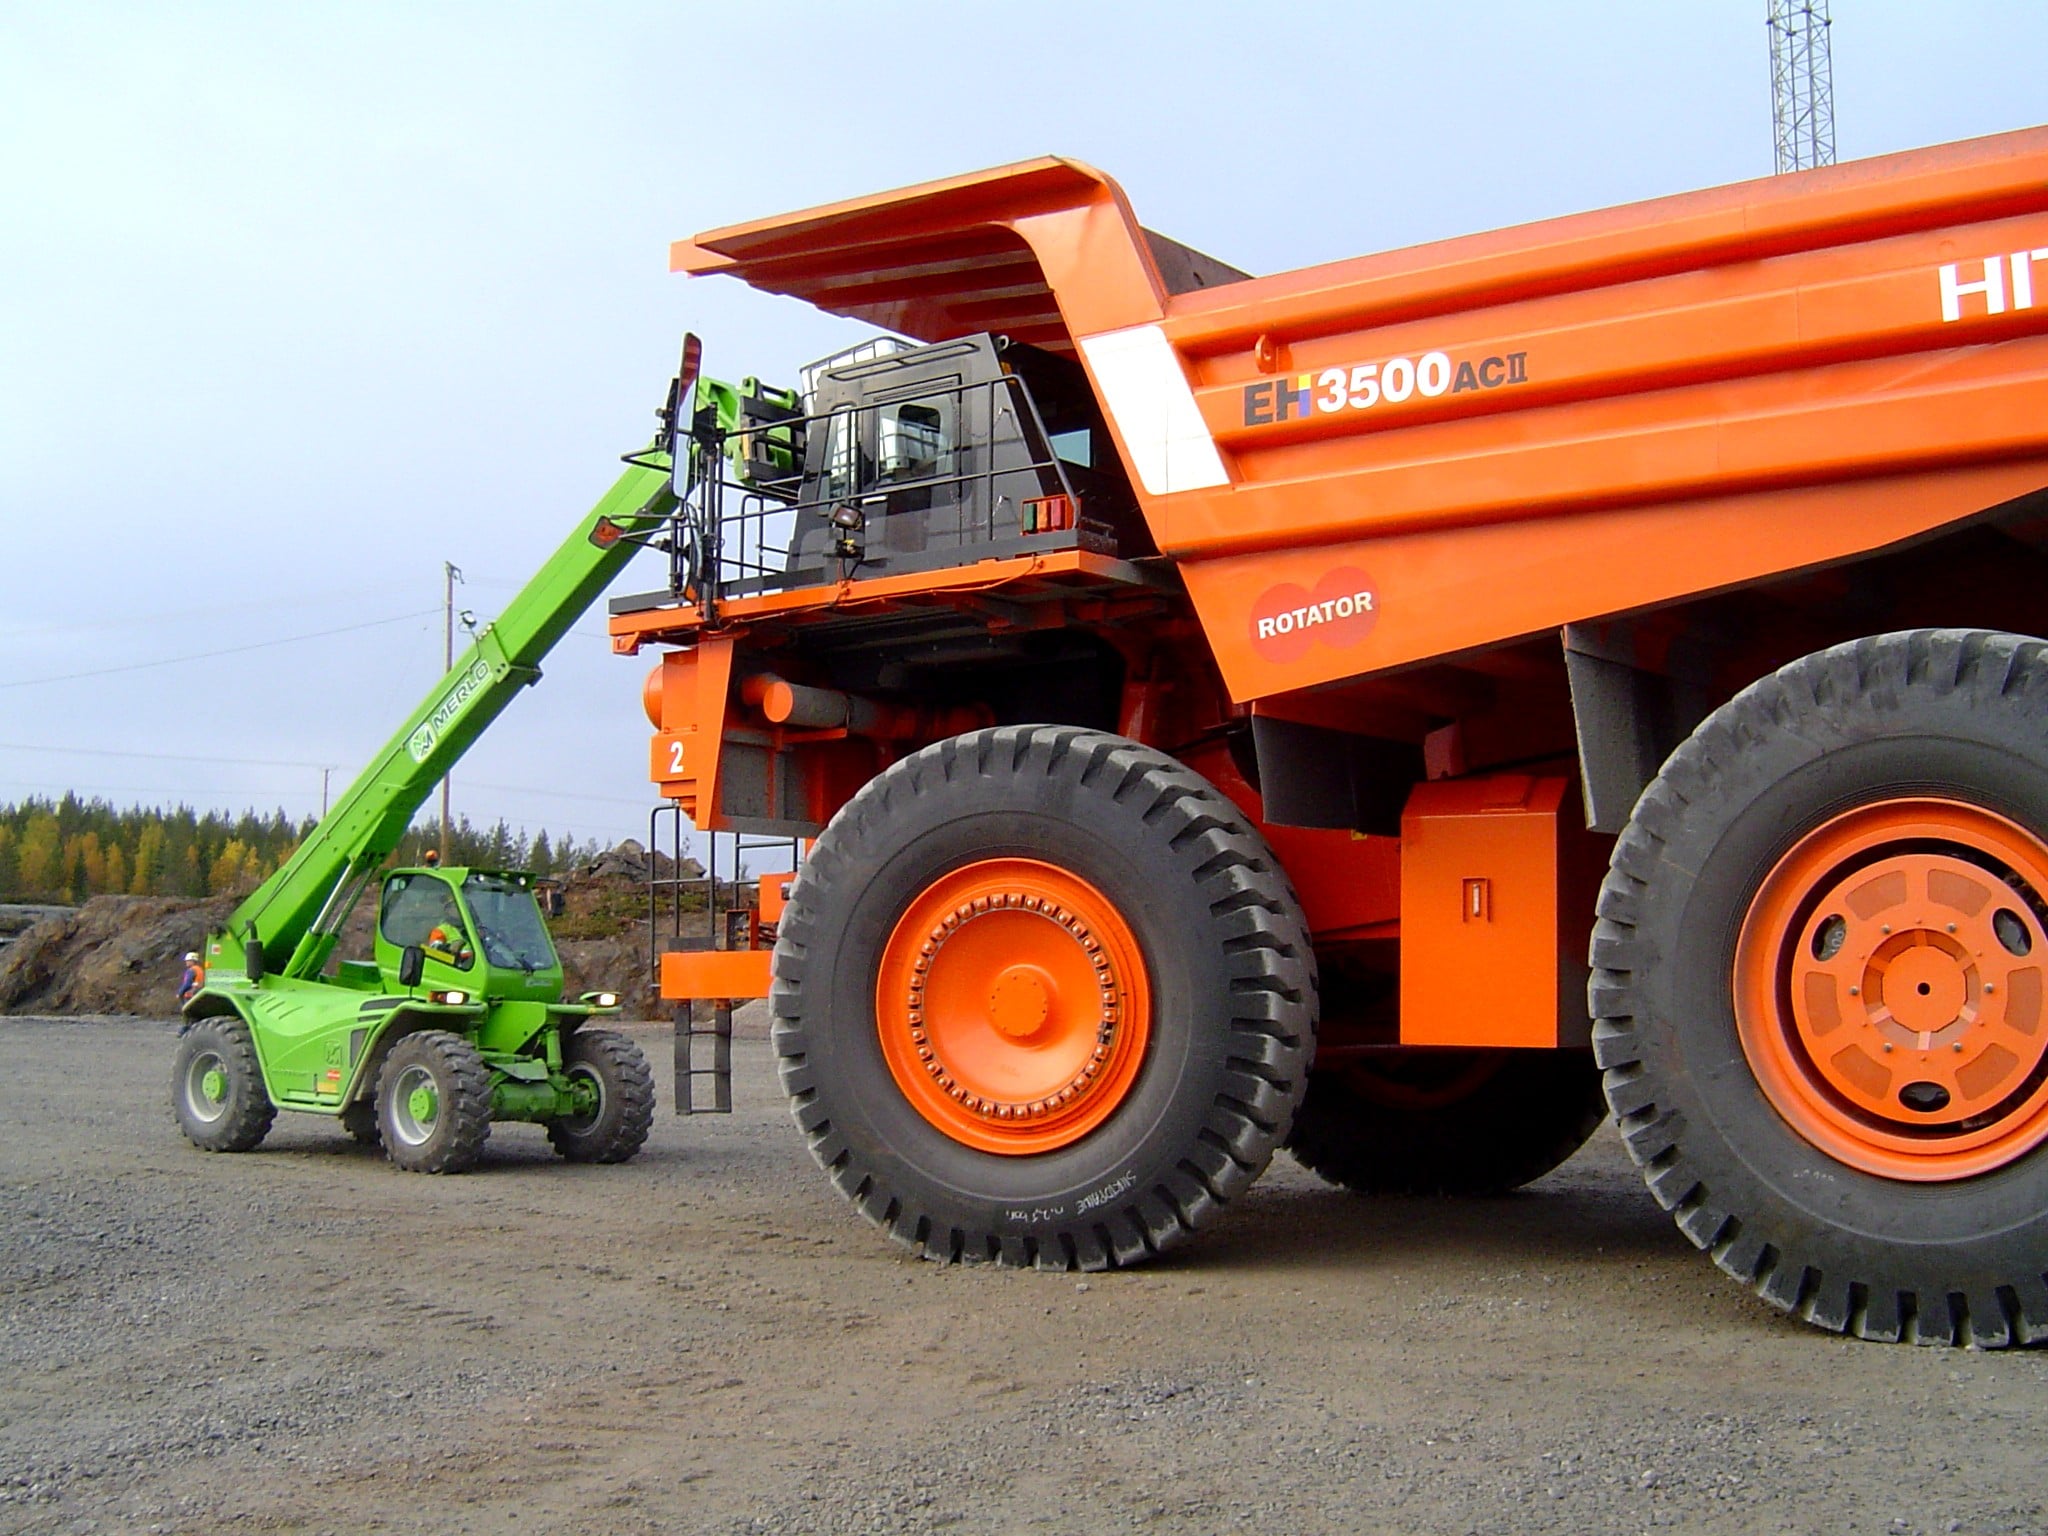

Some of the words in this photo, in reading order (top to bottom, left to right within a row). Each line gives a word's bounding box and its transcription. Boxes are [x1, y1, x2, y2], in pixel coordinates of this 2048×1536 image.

[1257, 591, 1374, 640] ROTATOR
[431, 661, 490, 731] MERLO
[669, 741, 684, 774] 2
